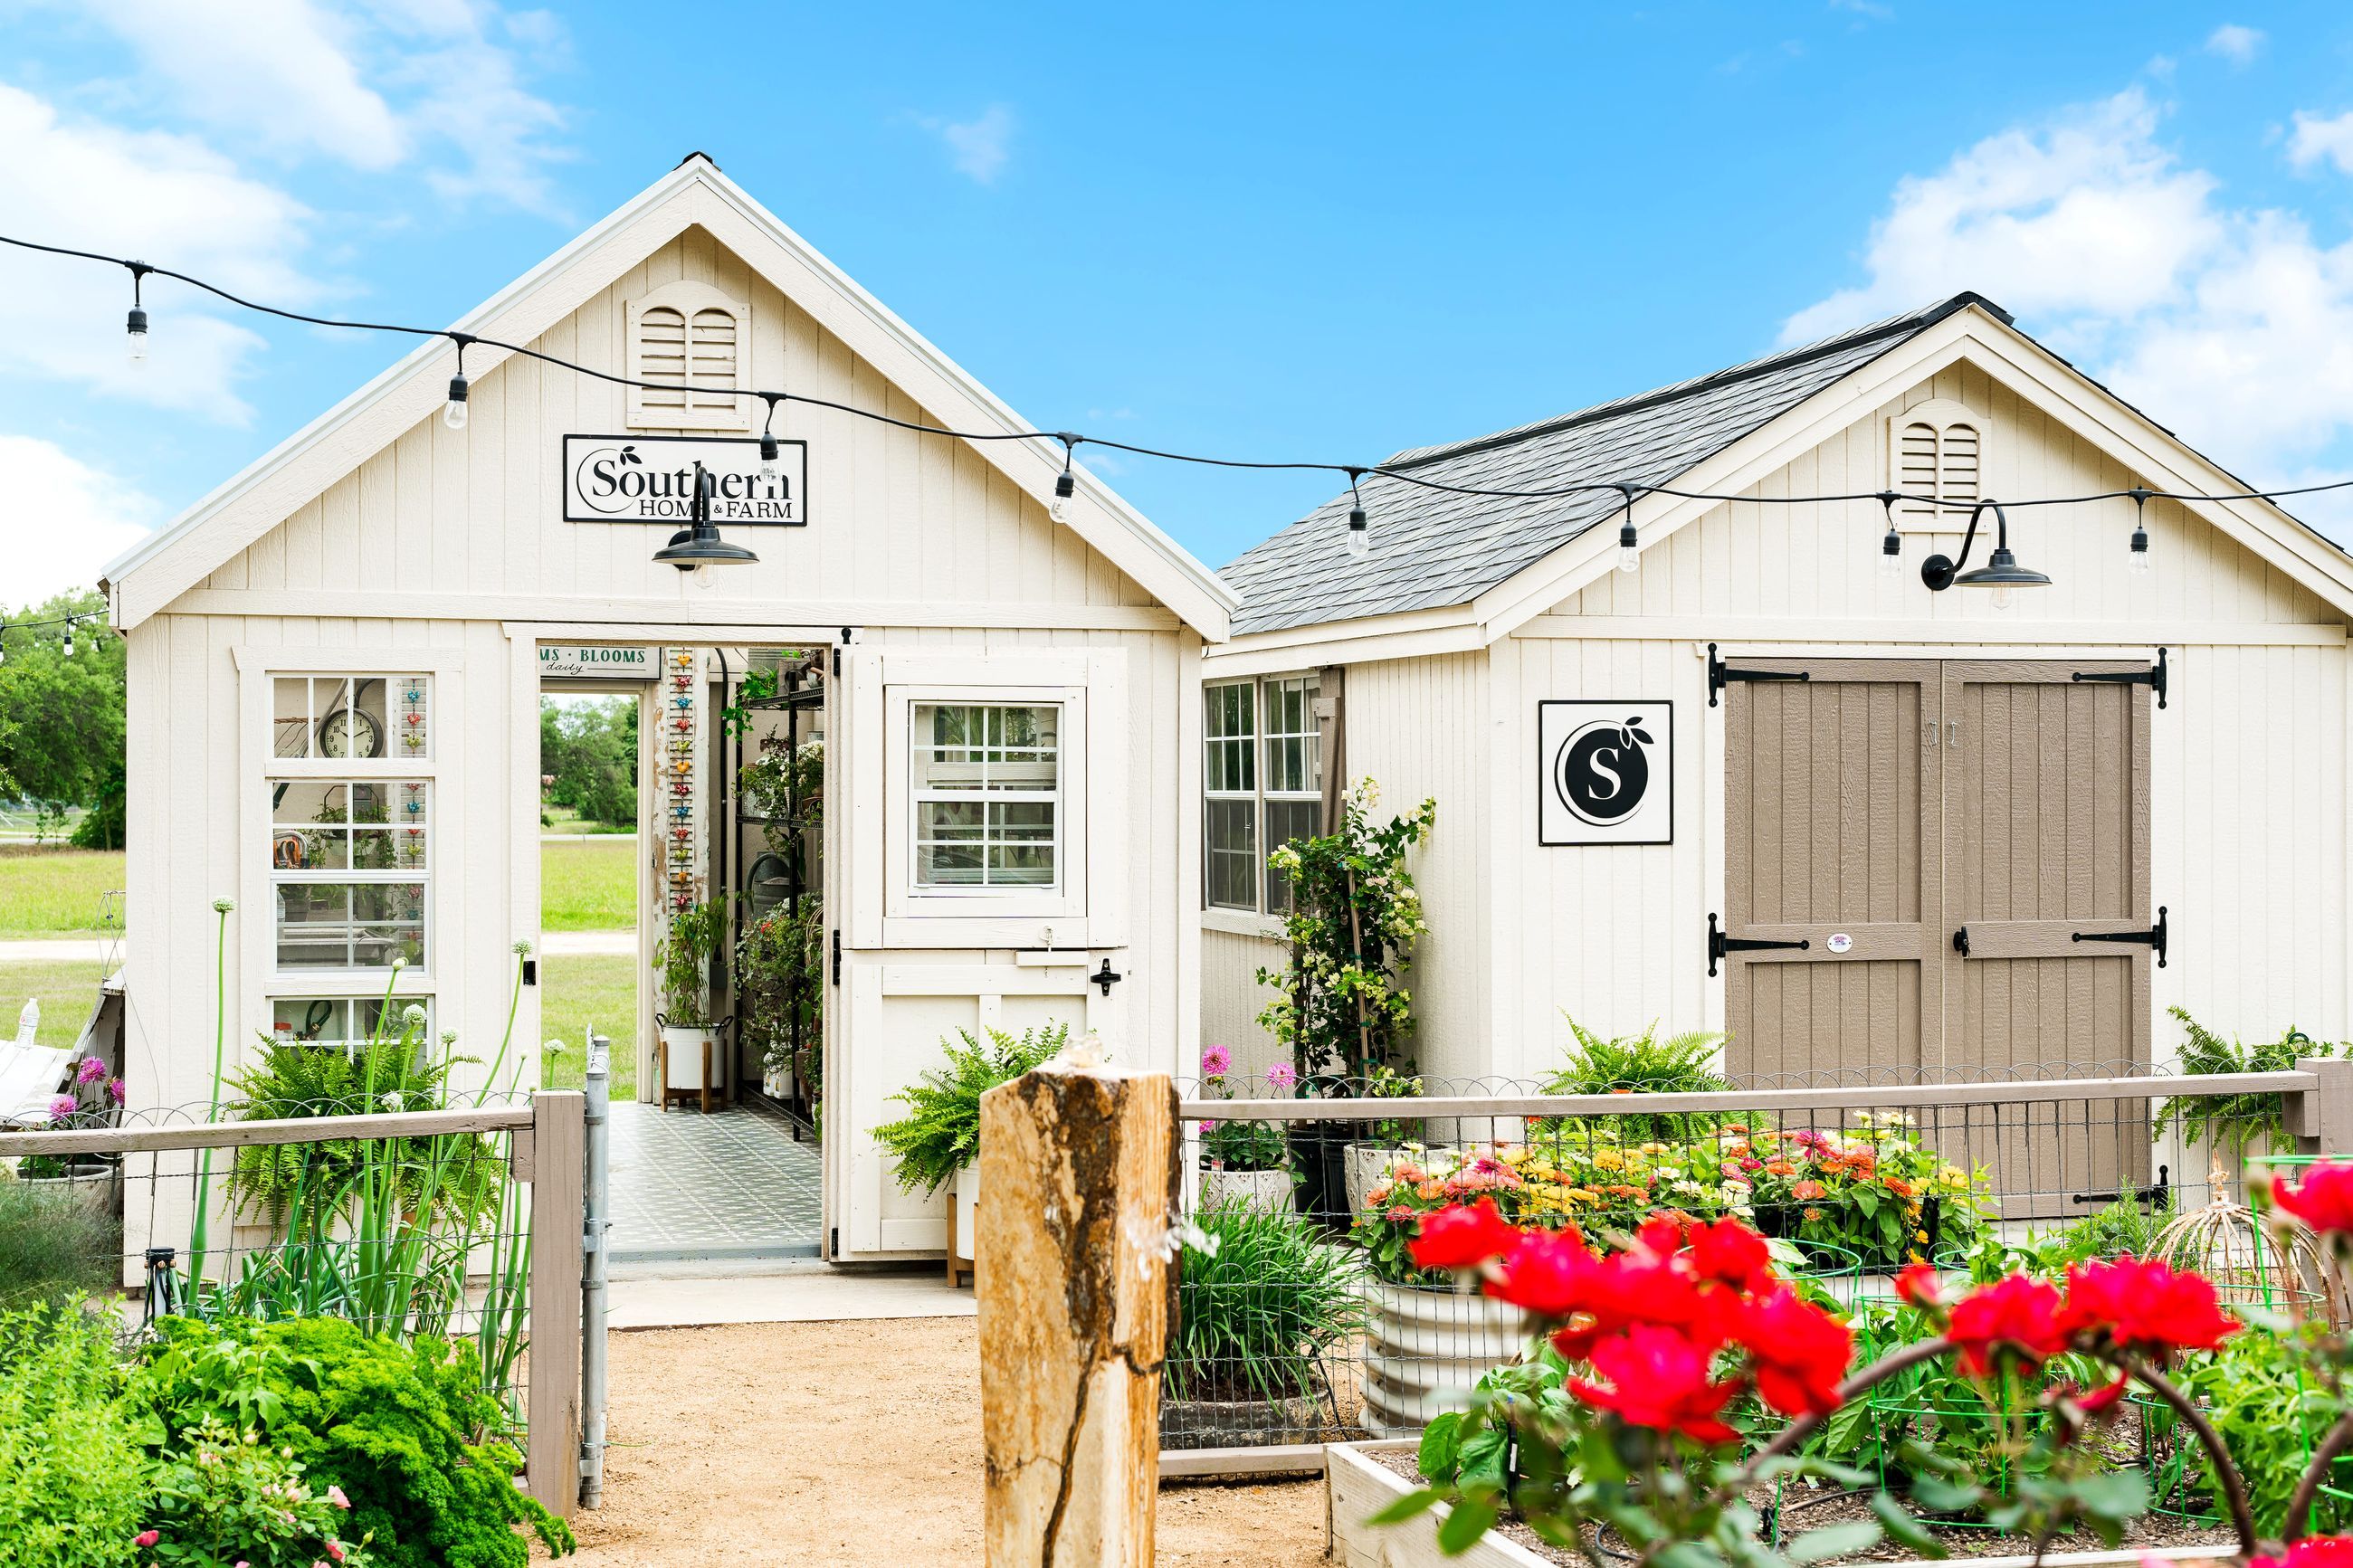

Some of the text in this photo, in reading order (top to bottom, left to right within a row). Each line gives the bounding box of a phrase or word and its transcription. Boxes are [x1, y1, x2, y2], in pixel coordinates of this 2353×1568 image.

[639, 499, 793, 518] HOM & FARM
[580, 649, 645, 663] BLOOMS
[546, 661, 585, 675] daily
[333, 726, 340, 734] 10
[329, 735, 334, 743] 9
[368, 735, 374, 743] 3
[333, 744, 338, 753] 8
[1587, 747, 1622, 800] S
